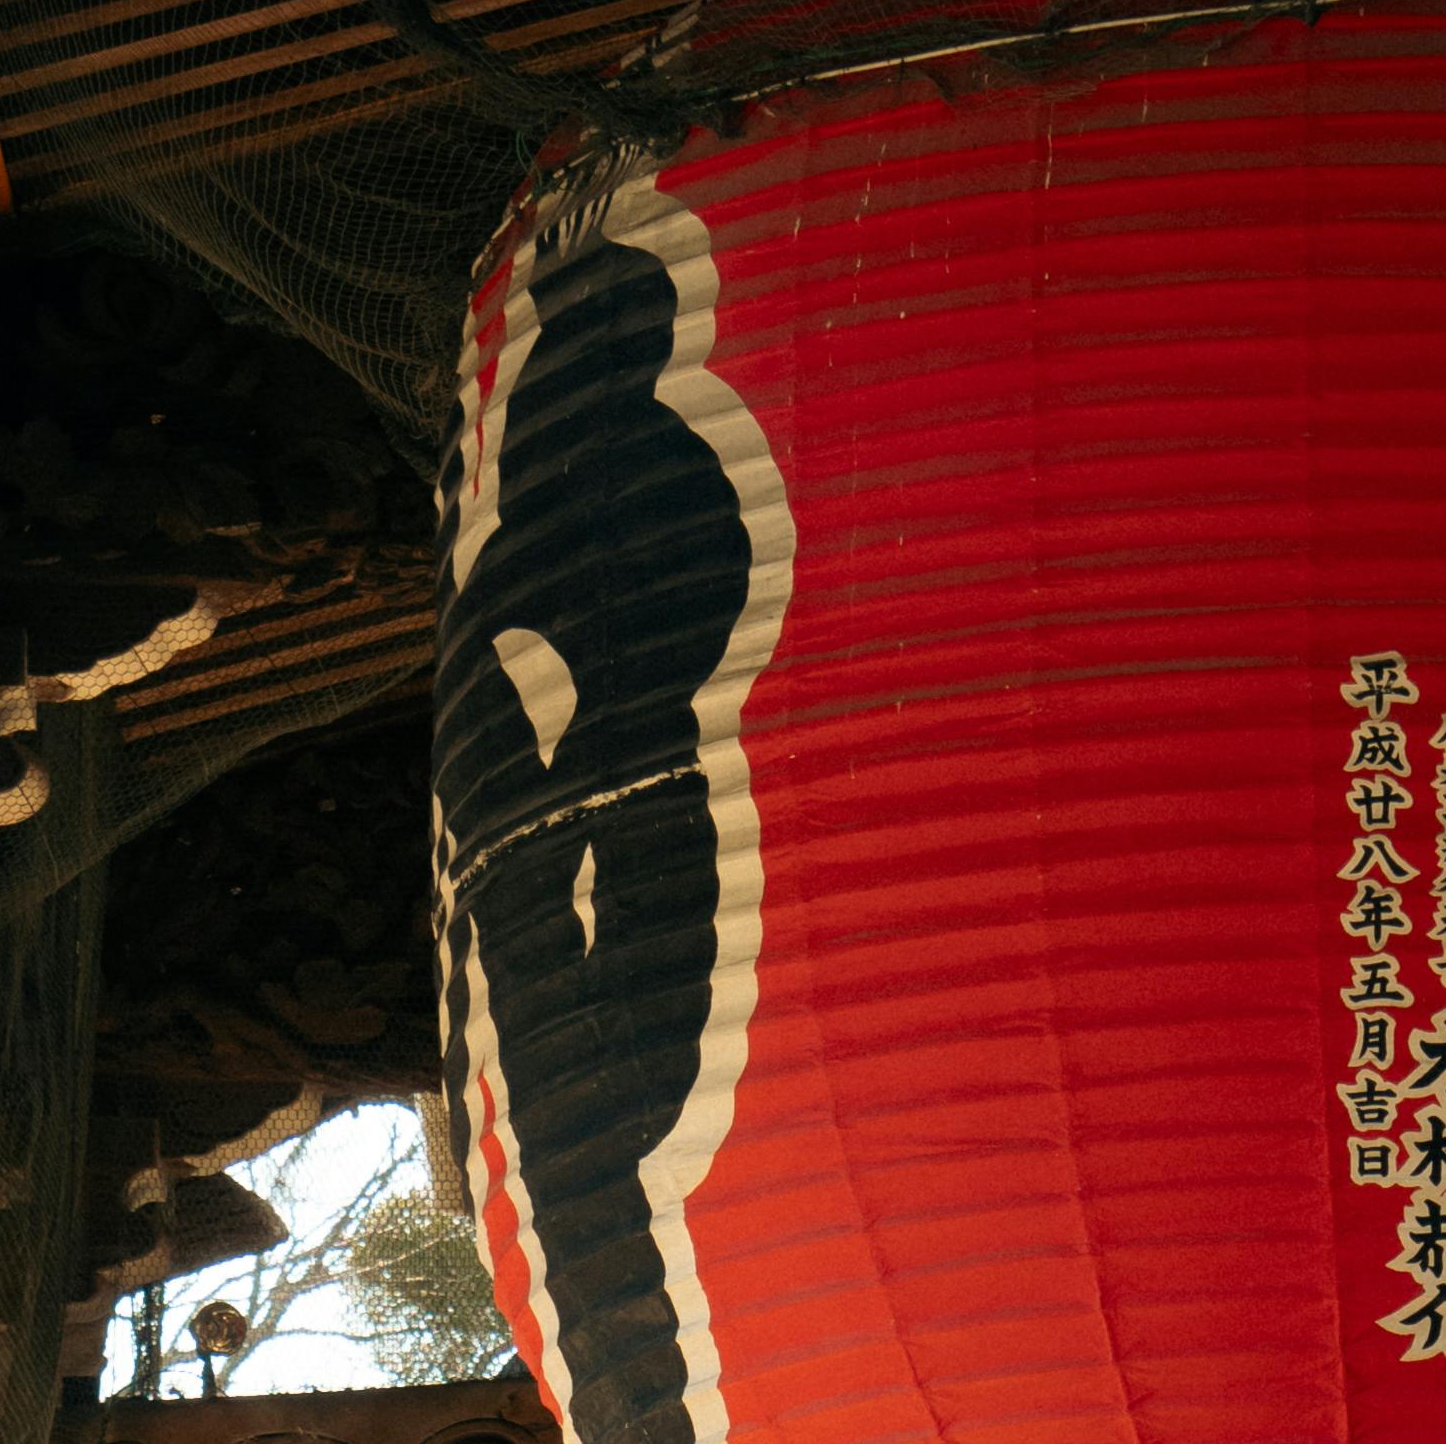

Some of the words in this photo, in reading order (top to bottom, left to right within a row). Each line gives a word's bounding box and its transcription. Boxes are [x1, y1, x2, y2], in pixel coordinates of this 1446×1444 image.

[1346, 657, 1411, 1179] 平成廿八年五月吉日
